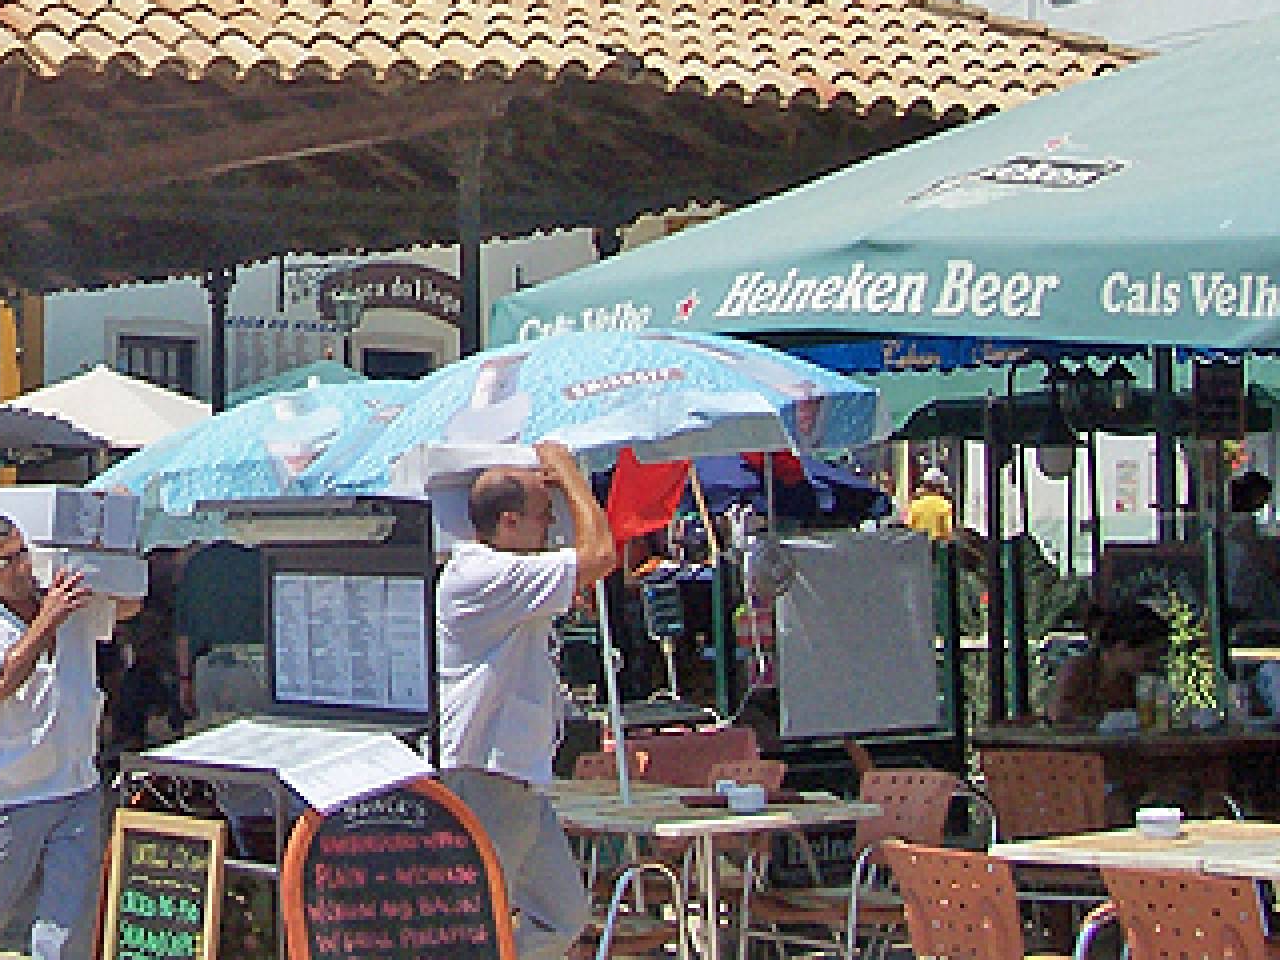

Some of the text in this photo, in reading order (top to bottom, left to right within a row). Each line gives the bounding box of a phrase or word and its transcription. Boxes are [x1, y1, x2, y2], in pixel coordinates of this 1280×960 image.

[712, 258, 1062, 319] Heineken Beer
[1099, 270, 1181, 316] Cais
